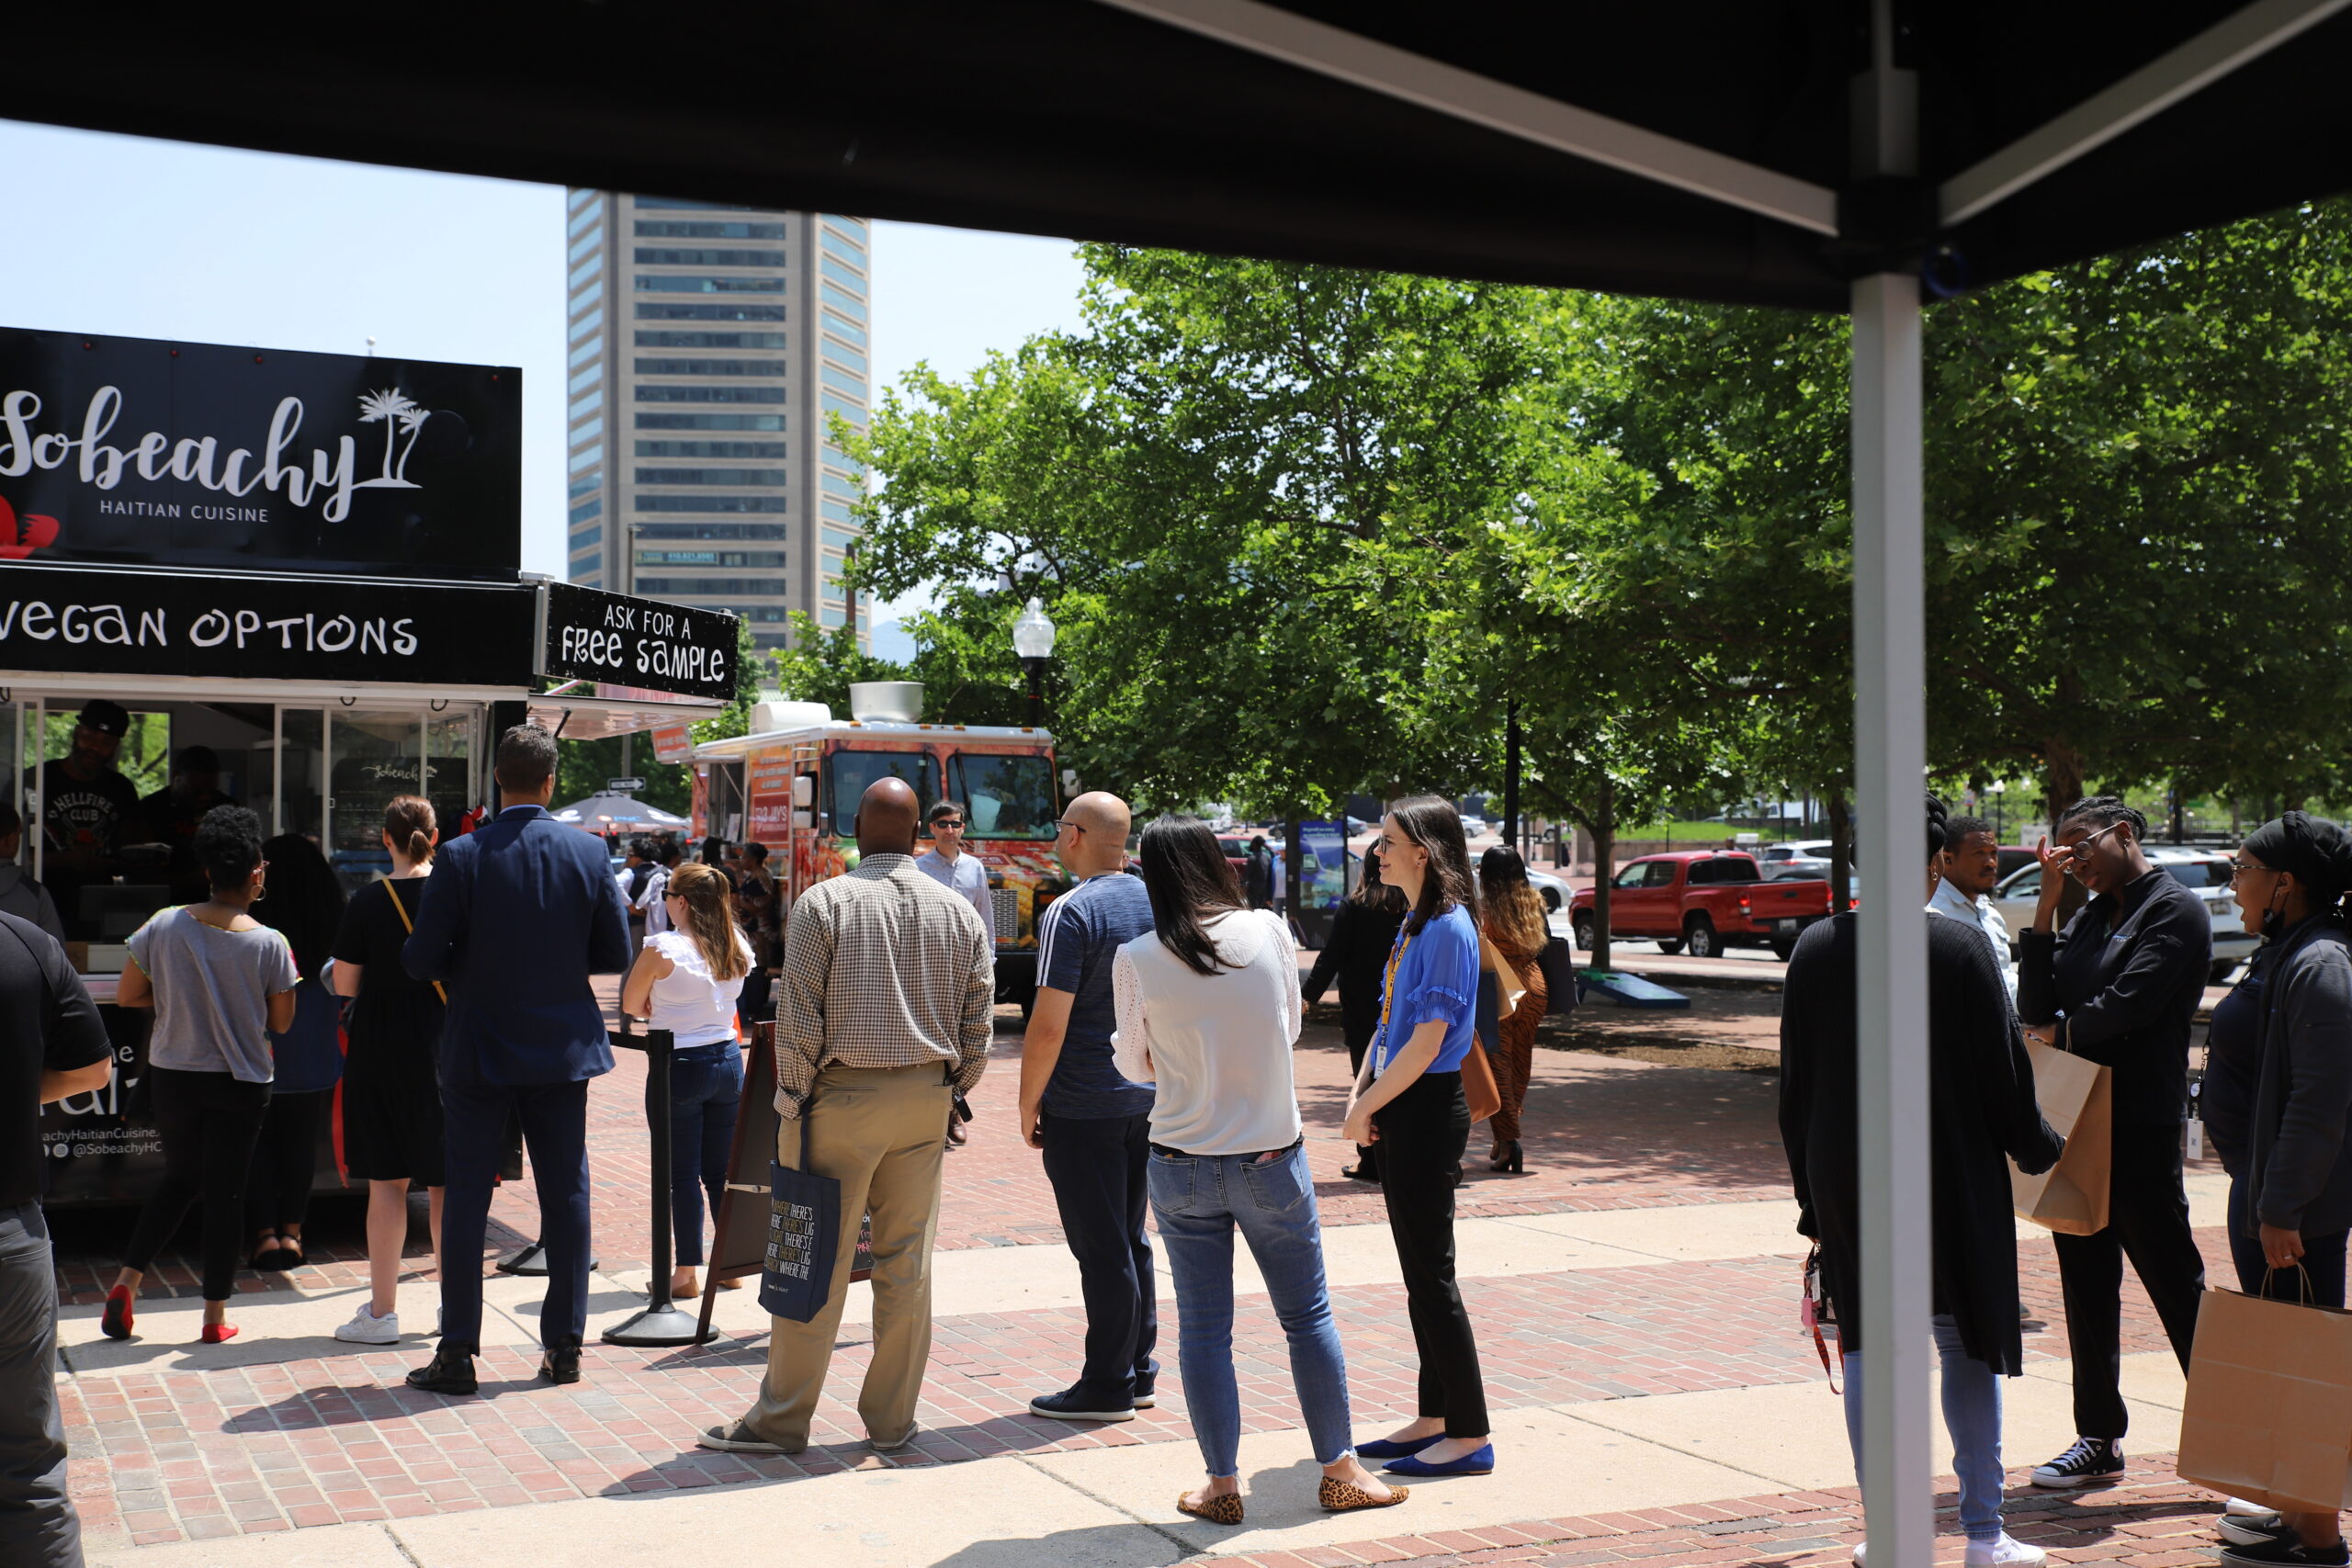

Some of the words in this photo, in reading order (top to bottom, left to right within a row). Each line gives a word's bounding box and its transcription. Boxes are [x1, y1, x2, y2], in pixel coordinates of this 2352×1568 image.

[0, 386, 356, 523] Sobeachy
[100, 499, 181, 518] HAITIAN
[190, 504, 269, 523] CUISINE
[189, 608, 418, 655] OPTIONS
[604, 604, 635, 631] ASK
[643, 610, 674, 637] FOR
[681, 617, 691, 639] A
[53, 791, 115, 815] HELLFIRE
[70, 808, 100, 821] CLUB
